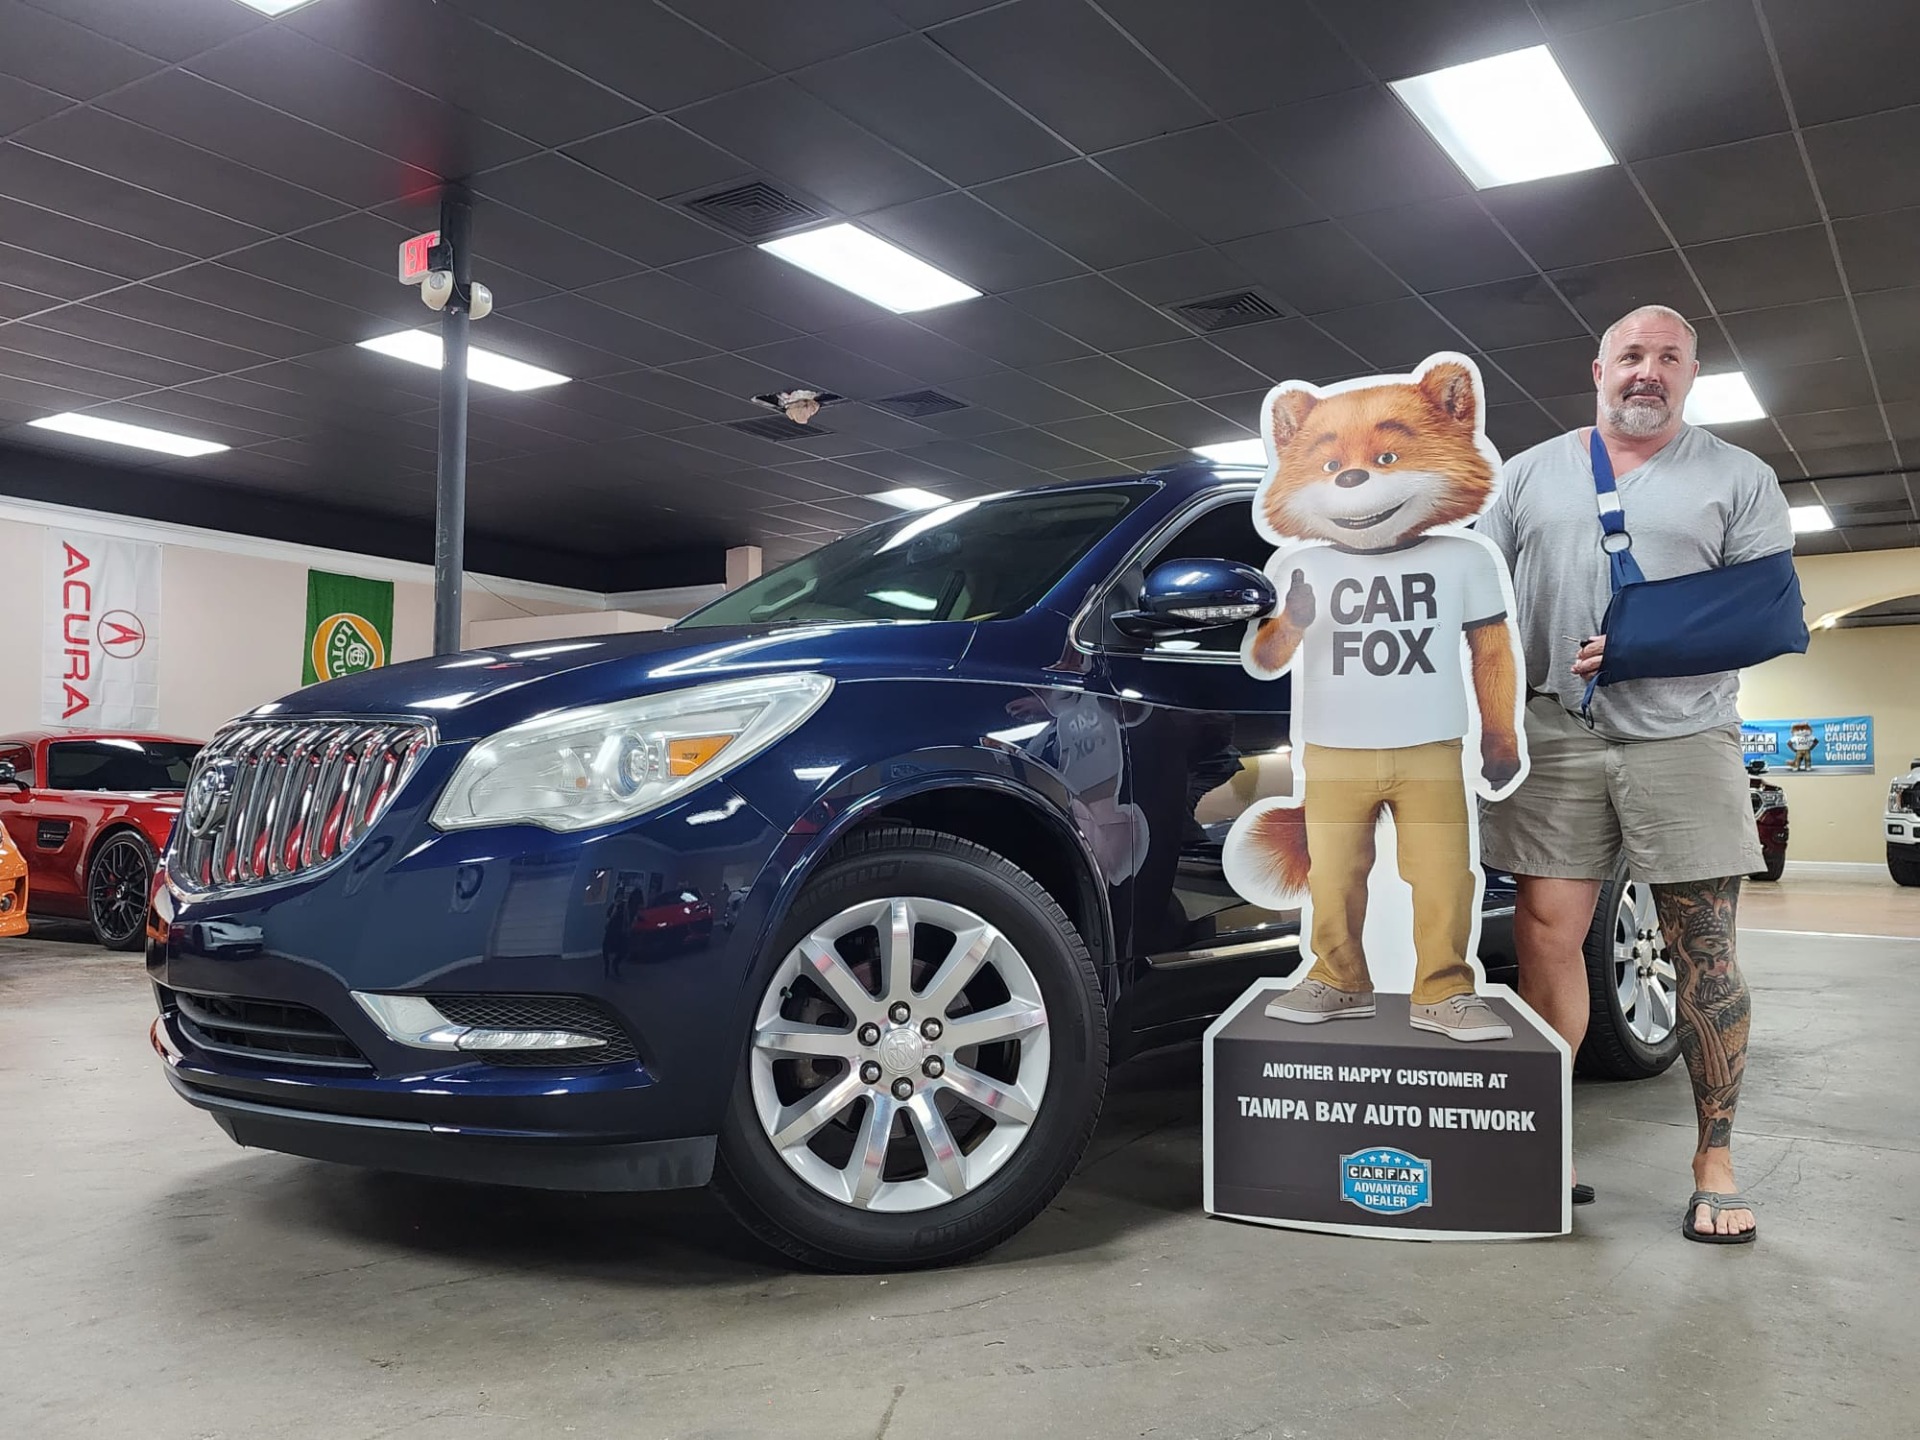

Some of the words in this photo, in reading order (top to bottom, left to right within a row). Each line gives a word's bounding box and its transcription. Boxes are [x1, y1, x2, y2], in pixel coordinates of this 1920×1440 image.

[1330, 572, 1438, 625] CAR
[62, 540, 91, 720] ACURA
[1332, 627, 1437, 677] FOX
[1824, 722, 1840, 732] We
[1843, 721, 1868, 732] have
[1824, 731, 1867, 742] CARFAX
[1825, 742, 1868, 752] 1-Owner
[1825, 751, 1867, 761] Vehicles
[1262, 1061, 1334, 1082] ANOTHER
[1338, 1065, 1392, 1085] HAPPY
[1396, 1068, 1484, 1089] CUSTOMER
[1488, 1073, 1508, 1089] AT
[1237, 1096, 1309, 1121] TAMPA
[1315, 1101, 1358, 1124] BAY
[1363, 1104, 1423, 1128] AUTO
[1428, 1108, 1537, 1132] NETWORK
[1349, 1165, 1422, 1182] CARFAX
[1354, 1181, 1418, 1196] ADVANTAGE
[1365, 1194, 1408, 1207] DEALER
